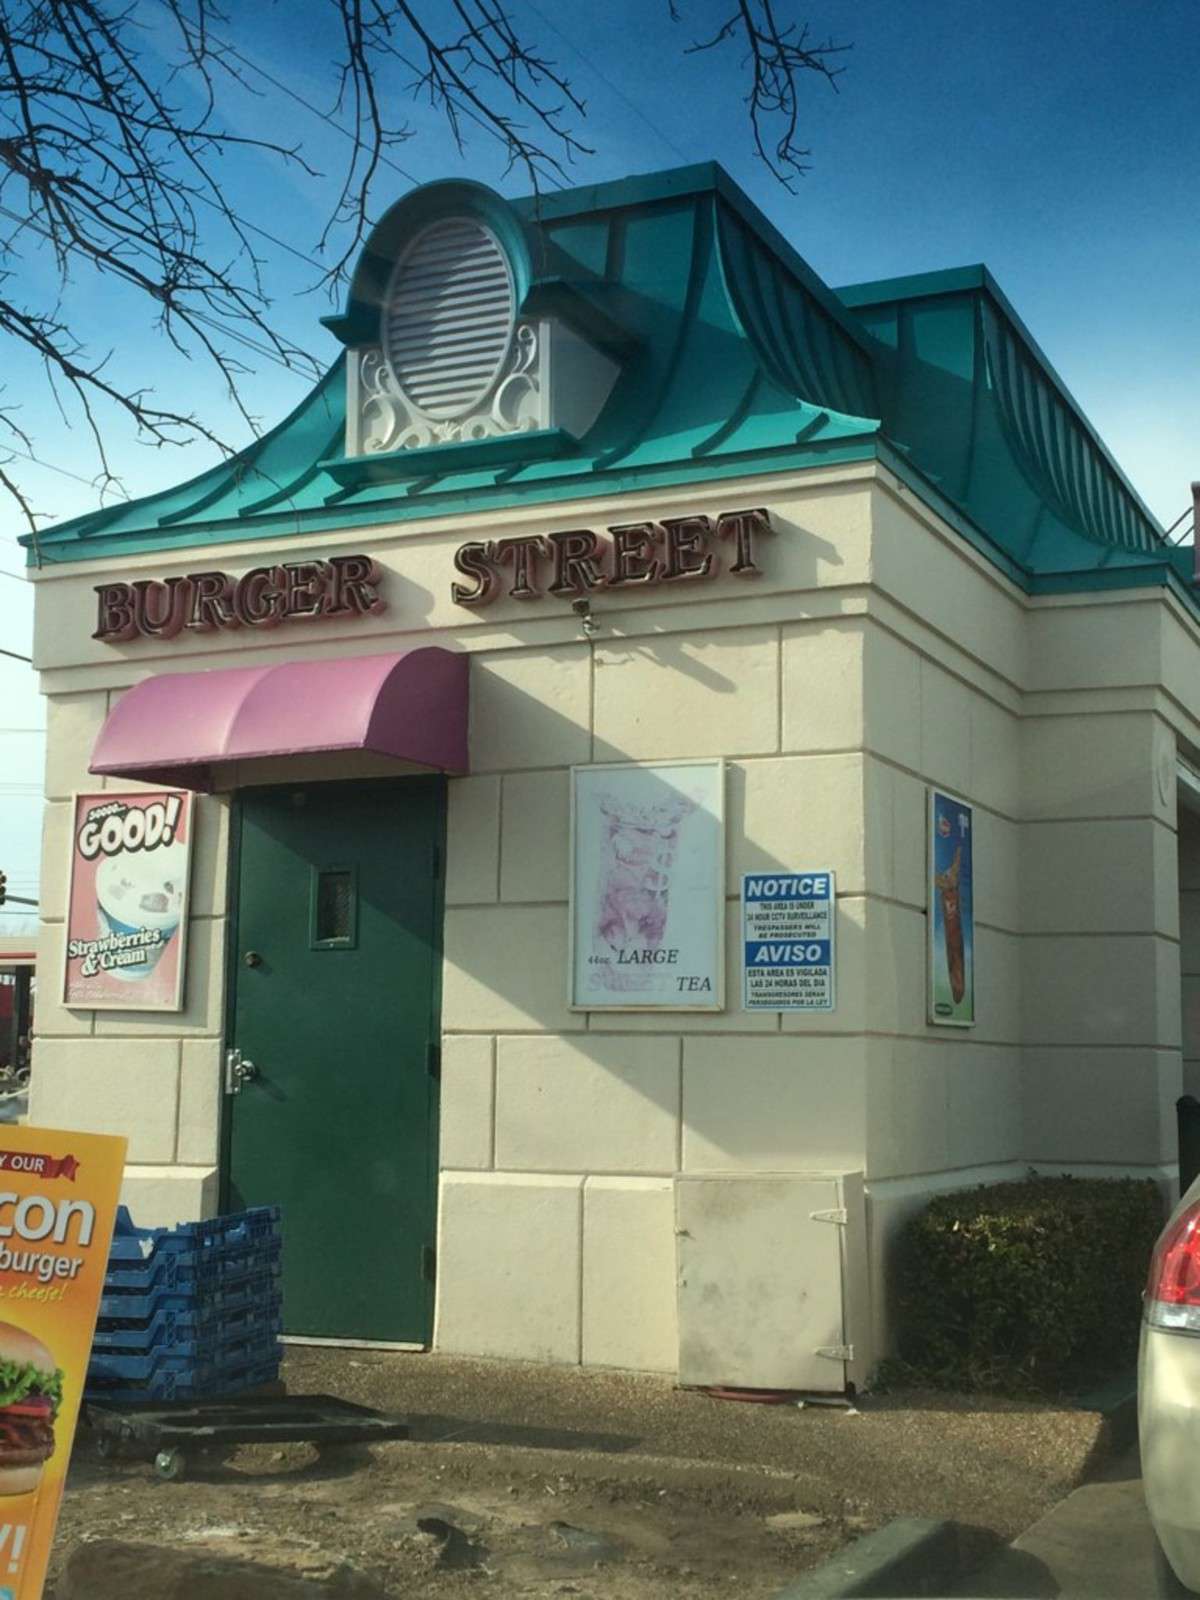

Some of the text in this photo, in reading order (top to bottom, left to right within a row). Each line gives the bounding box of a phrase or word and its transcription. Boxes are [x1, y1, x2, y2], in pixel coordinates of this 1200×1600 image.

[92, 507, 775, 642] BURGER STREET
[79, 795, 181, 859] GOOD!
[748, 879, 827, 896] NOTICE
[68, 927, 160, 957] Strawberries
[100, 949, 146, 968] Cream
[616, 949, 680, 965] LARGE
[755, 945, 821, 962] AVISO
[748, 969, 765, 977] ESTA
[786, 968, 794, 976] ES
[676, 976, 712, 992] TEA
[750, 979, 763, 988] LAS
[774, 979, 798, 987] HORAS
[10, 1155, 45, 1172] OUR
[0, 1192, 95, 1246] con
